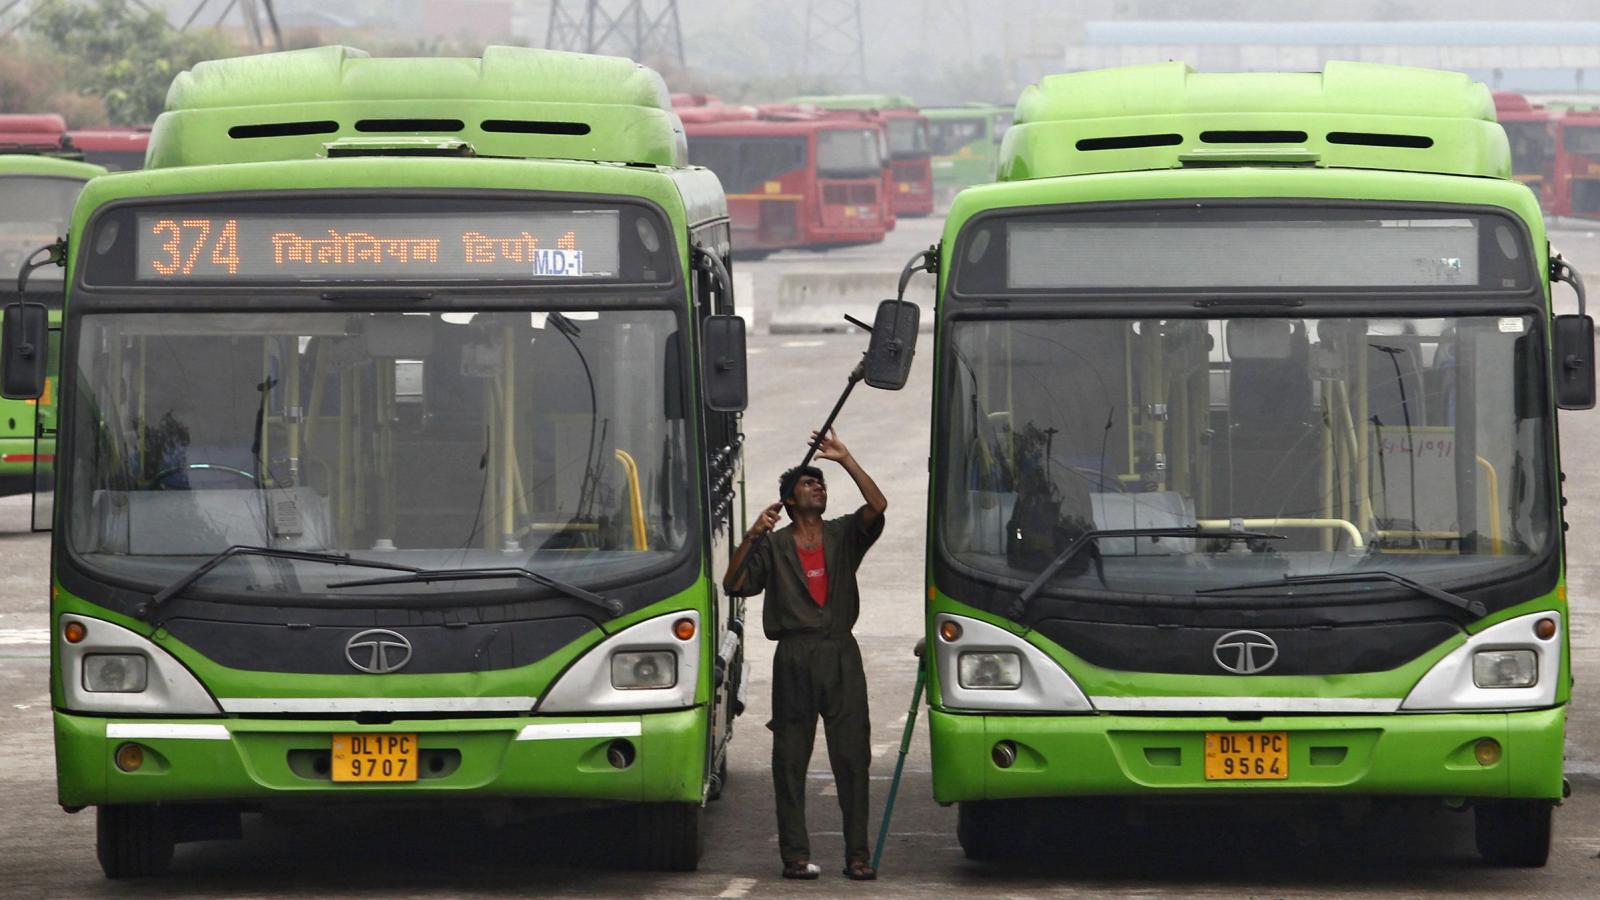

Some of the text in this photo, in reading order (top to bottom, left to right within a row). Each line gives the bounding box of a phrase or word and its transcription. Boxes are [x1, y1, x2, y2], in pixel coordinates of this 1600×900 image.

[153, 219, 239, 274] 374
[534, 249, 582, 276] M.D.-1
[351, 758, 408, 777] 9707
[1224, 757, 1280, 775] 9564
